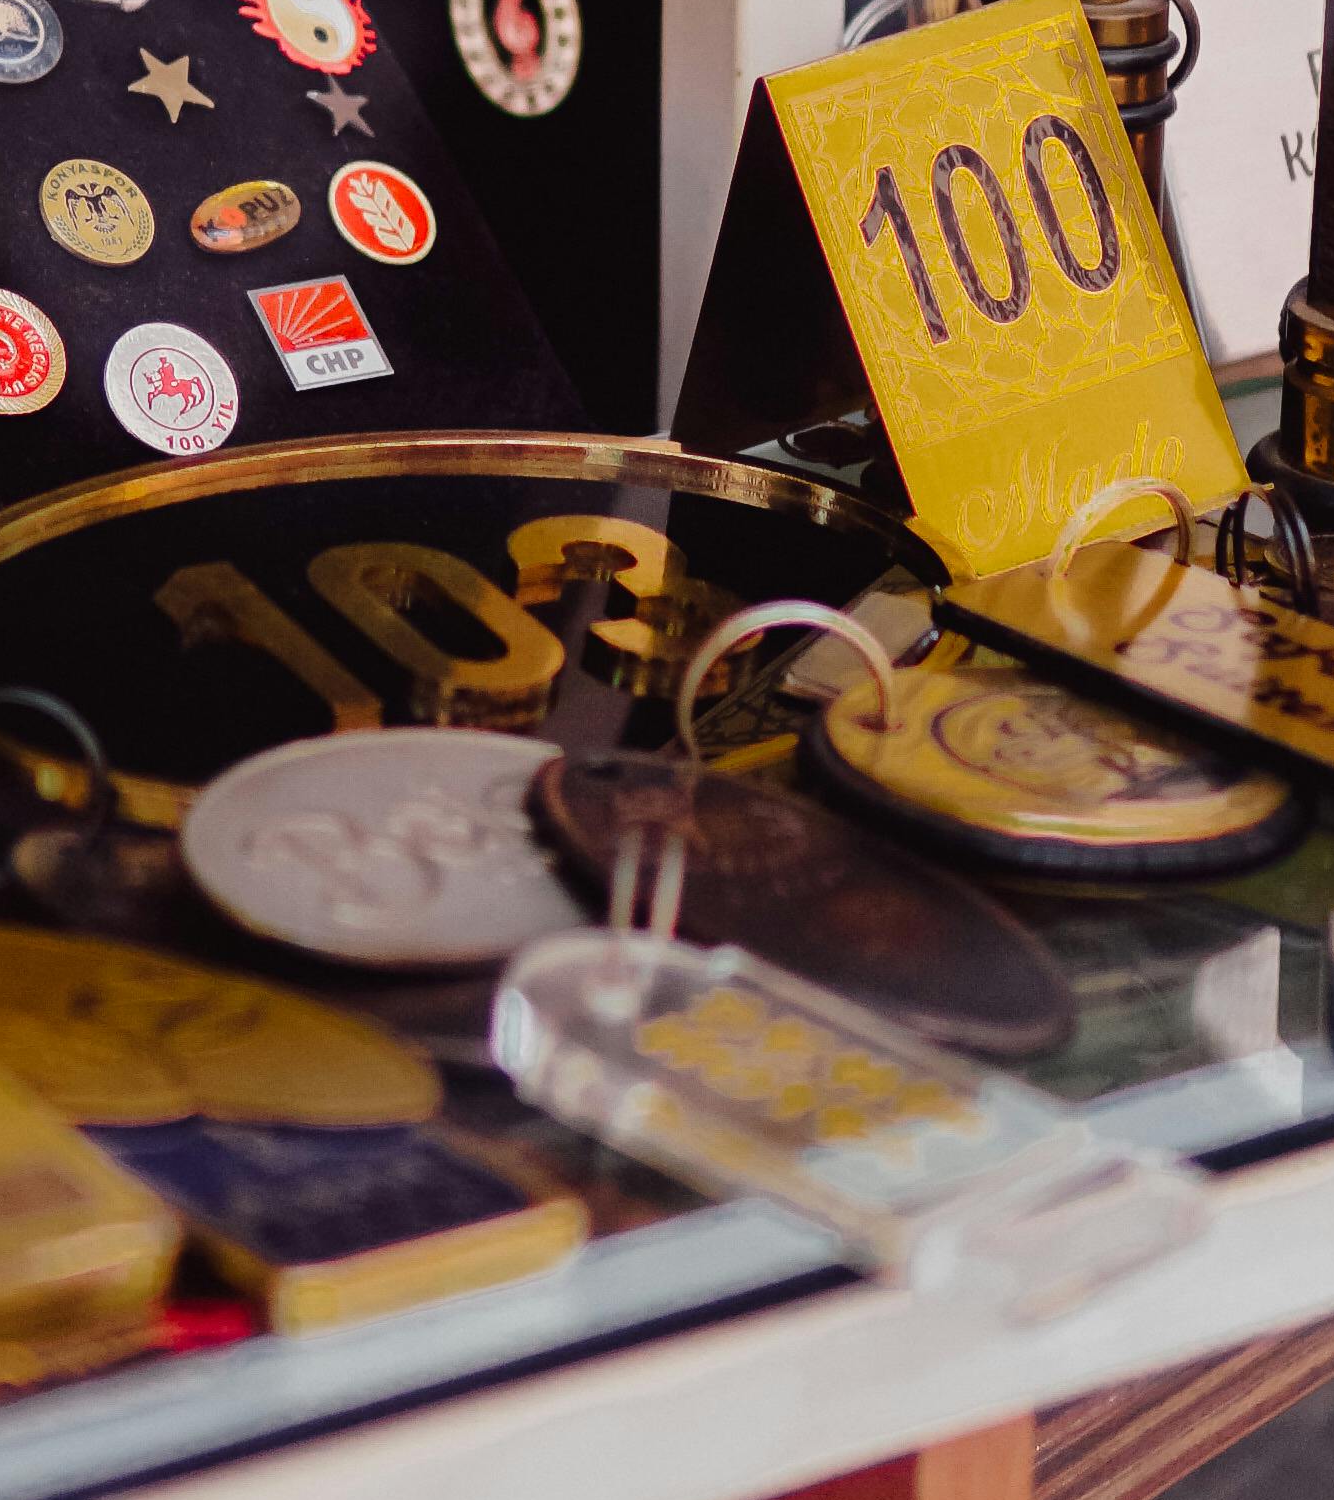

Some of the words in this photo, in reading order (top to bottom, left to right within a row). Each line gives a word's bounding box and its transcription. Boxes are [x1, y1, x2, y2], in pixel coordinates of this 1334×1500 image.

[46, 162, 139, 202] KONYASPOR
[857, 114, 1123, 346] 100
[305, 347, 366, 376] CHP
[210, 399, 235, 432] YIL
